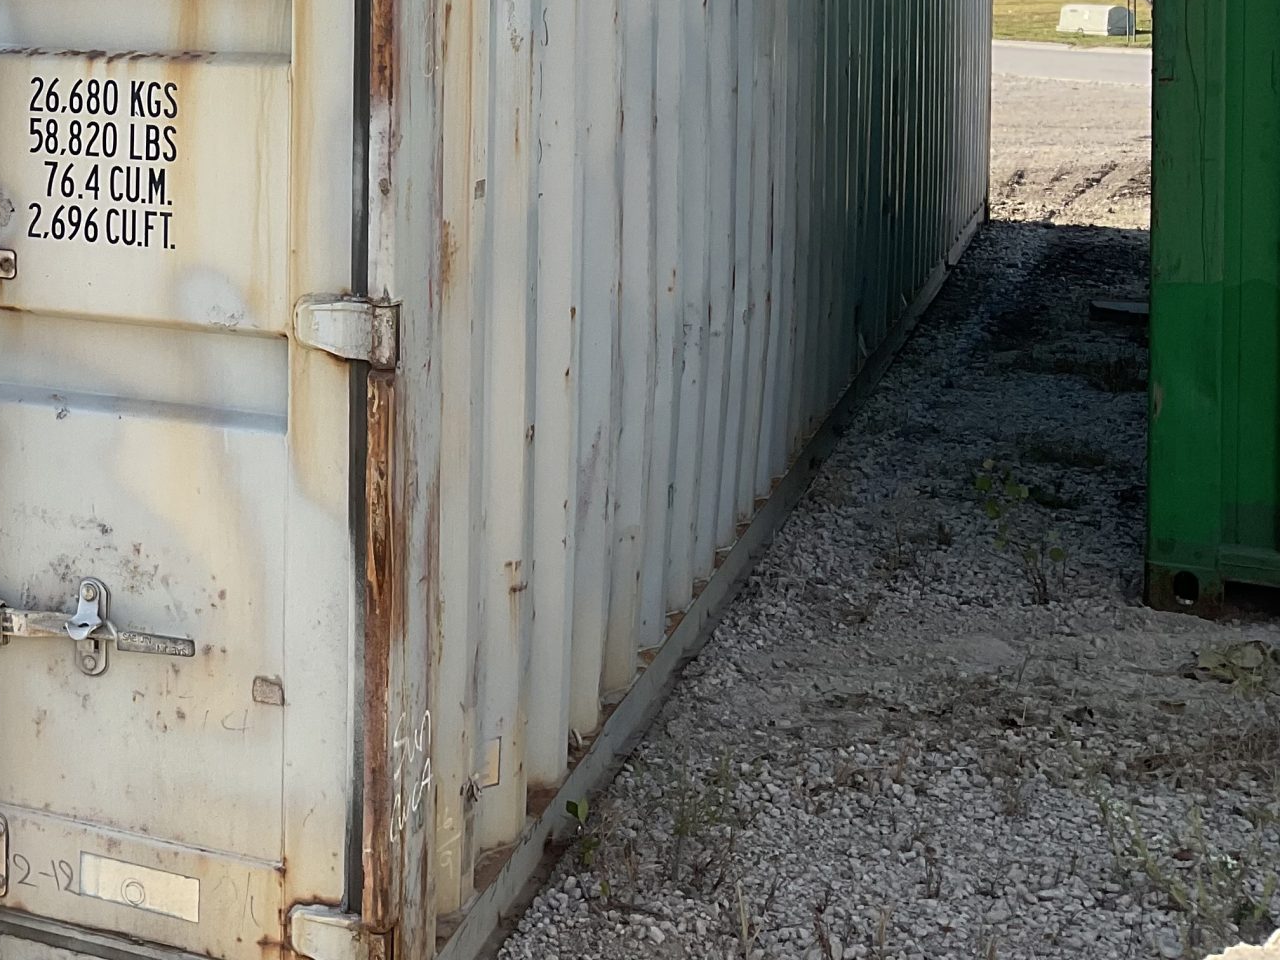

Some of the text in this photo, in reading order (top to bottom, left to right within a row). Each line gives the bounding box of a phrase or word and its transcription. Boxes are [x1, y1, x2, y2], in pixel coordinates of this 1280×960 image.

[29, 76, 119, 116] 26,680
[130, 80, 178, 119] KGS
[29, 117, 177, 162] 58,820 LBS
[44, 160, 100, 201] 76.4
[109, 165, 173, 206] CU.M.
[27, 202, 176, 250] 2,696 CU.FT.
